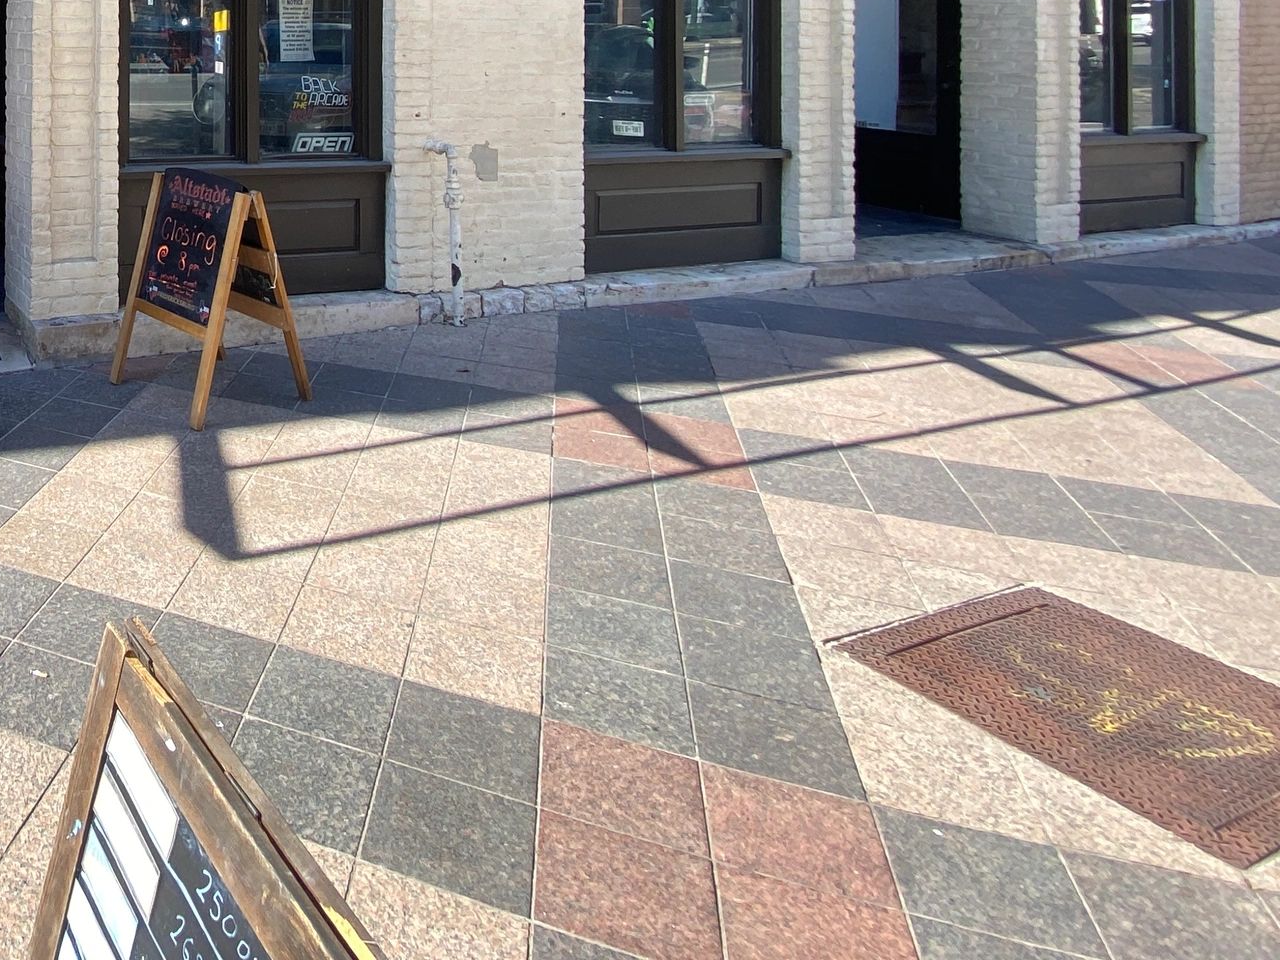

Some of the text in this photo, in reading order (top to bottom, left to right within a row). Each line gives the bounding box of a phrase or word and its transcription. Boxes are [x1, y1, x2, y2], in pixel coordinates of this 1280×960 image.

[301, 75, 340, 93] BACK
[293, 101, 308, 110] THE
[295, 92, 349, 106] TO ARCADE
[296, 137, 351, 153] OPEN
[161, 216, 217, 266] Closing
